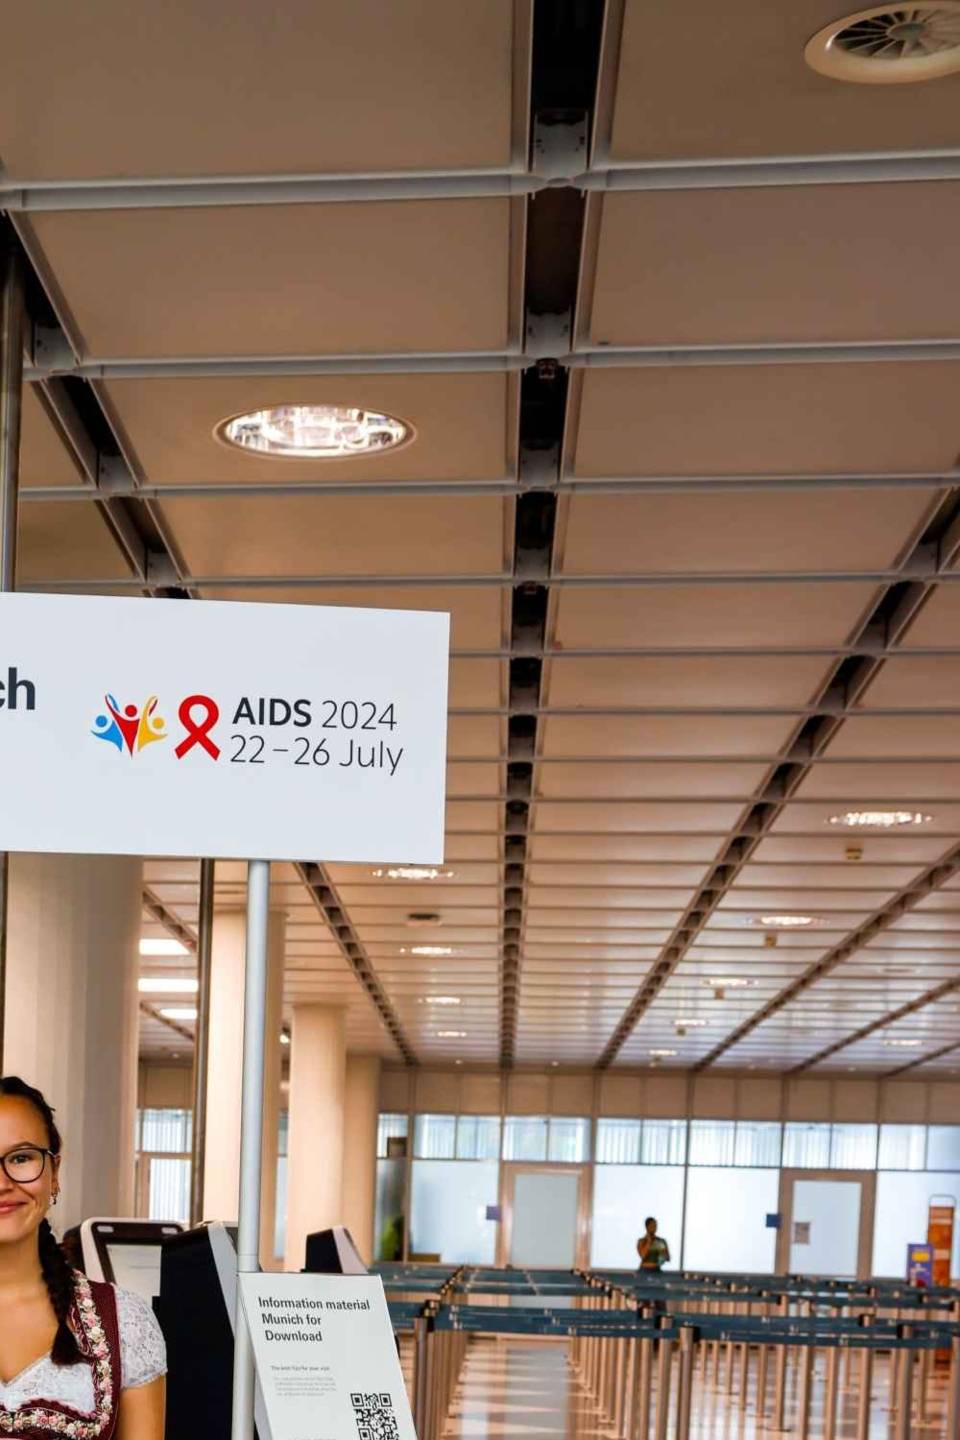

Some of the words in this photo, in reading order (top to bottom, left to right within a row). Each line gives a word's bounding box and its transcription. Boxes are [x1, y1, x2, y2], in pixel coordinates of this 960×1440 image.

[231, 696, 312, 728] AIDS
[321, 699, 398, 732] 2024
[338, 738, 404, 777] July
[257, 1296, 324, 1310] Information
[325, 1299, 371, 1311] material
[261, 1312, 304, 1325] Munich
[305, 1313, 323, 1326] for
[264, 1329, 323, 1343] Download
